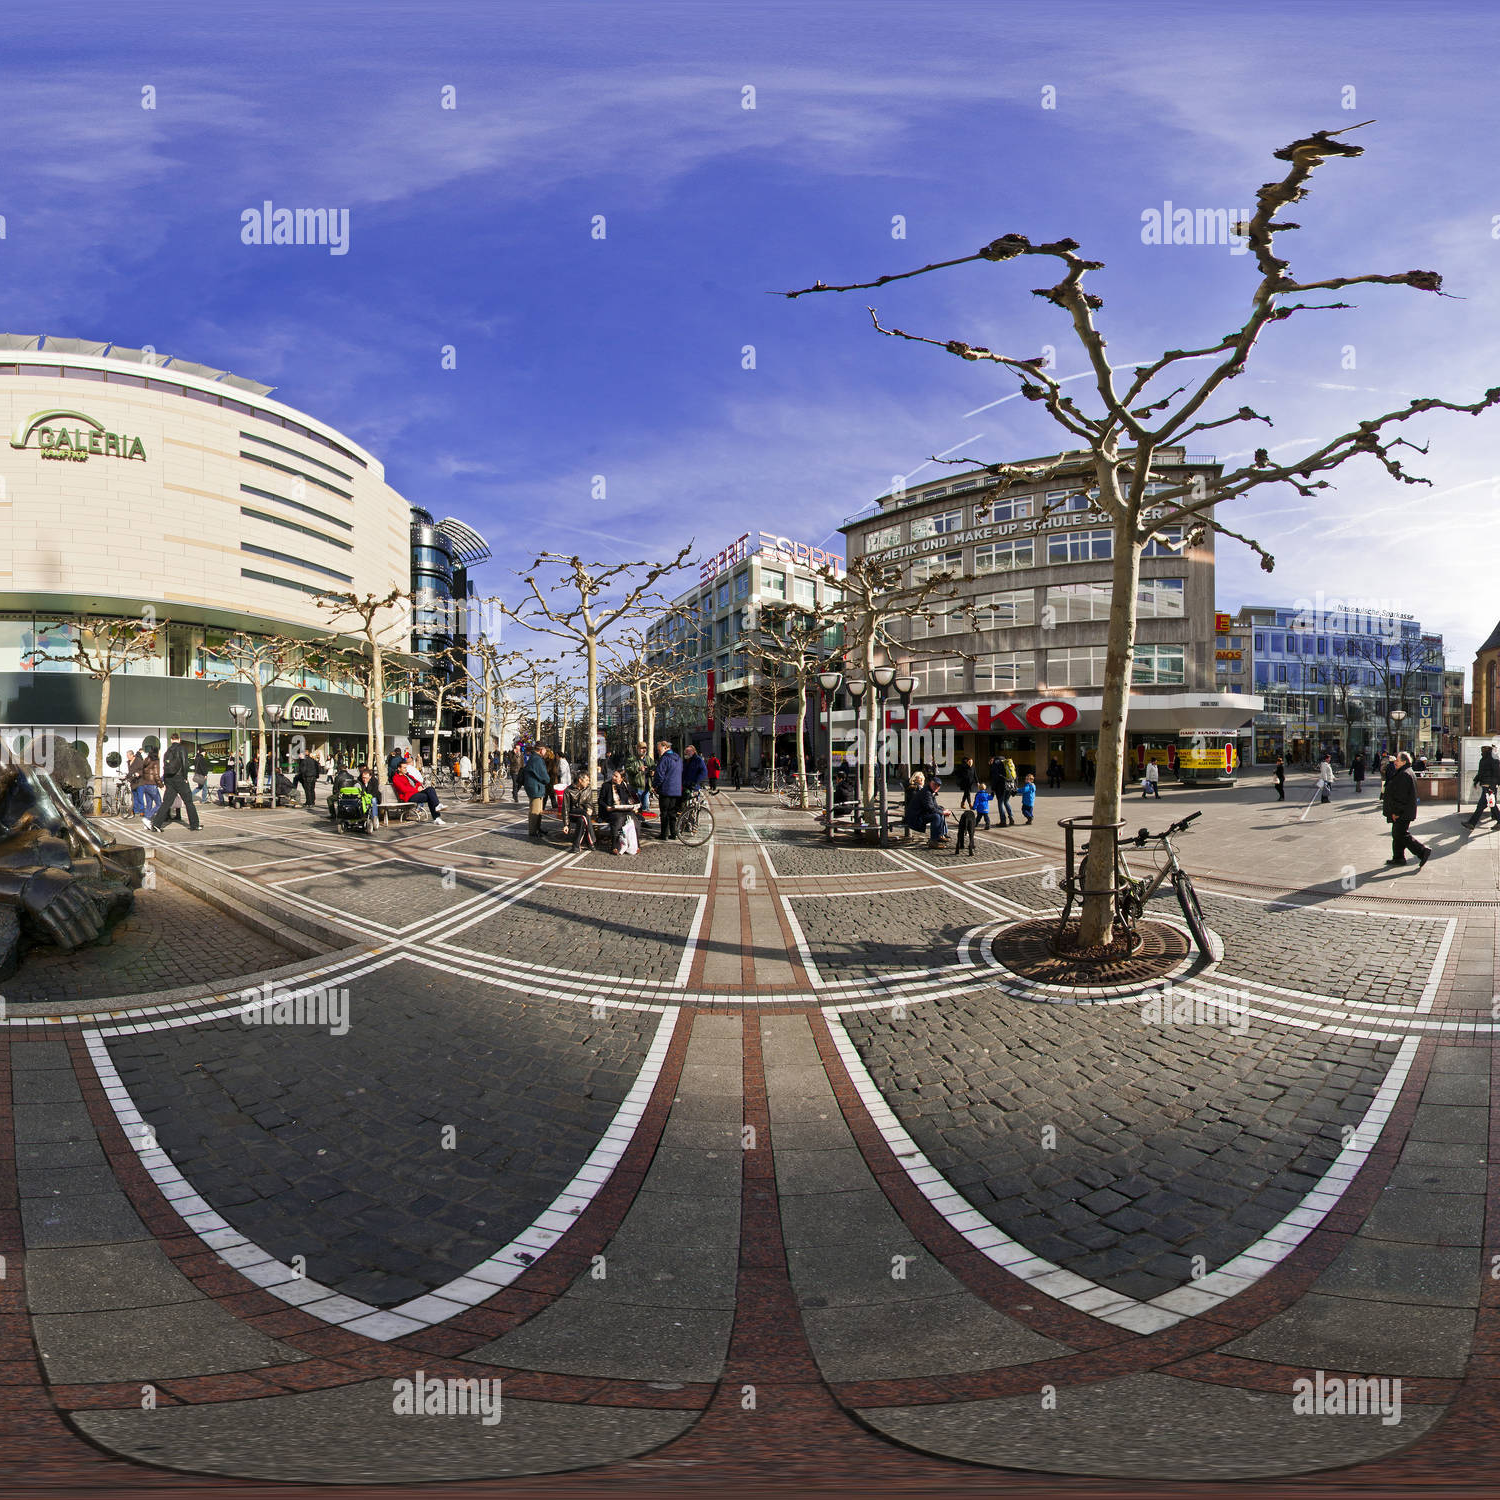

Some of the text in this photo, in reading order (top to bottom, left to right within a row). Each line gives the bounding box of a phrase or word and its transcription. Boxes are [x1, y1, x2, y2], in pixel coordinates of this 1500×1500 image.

[39, 426, 147, 462] GALERIA
[759, 531, 844, 579] ESPRIT
[862, 543, 919, 567] KOSMETIK
[922, 537, 948, 551] UND
[954, 523, 1018, 544] MAKE-UP
[1023, 513, 1082, 532] SCHULE
[700, 531, 752, 588] ESPRIT
[1382, 609, 1414, 620] Sparkasse
[293, 705, 330, 722] GALERIA
[886, 701, 1078, 732] HAKO
[1421, 708, 1430, 718] U
[1422, 697, 1429, 705] S
